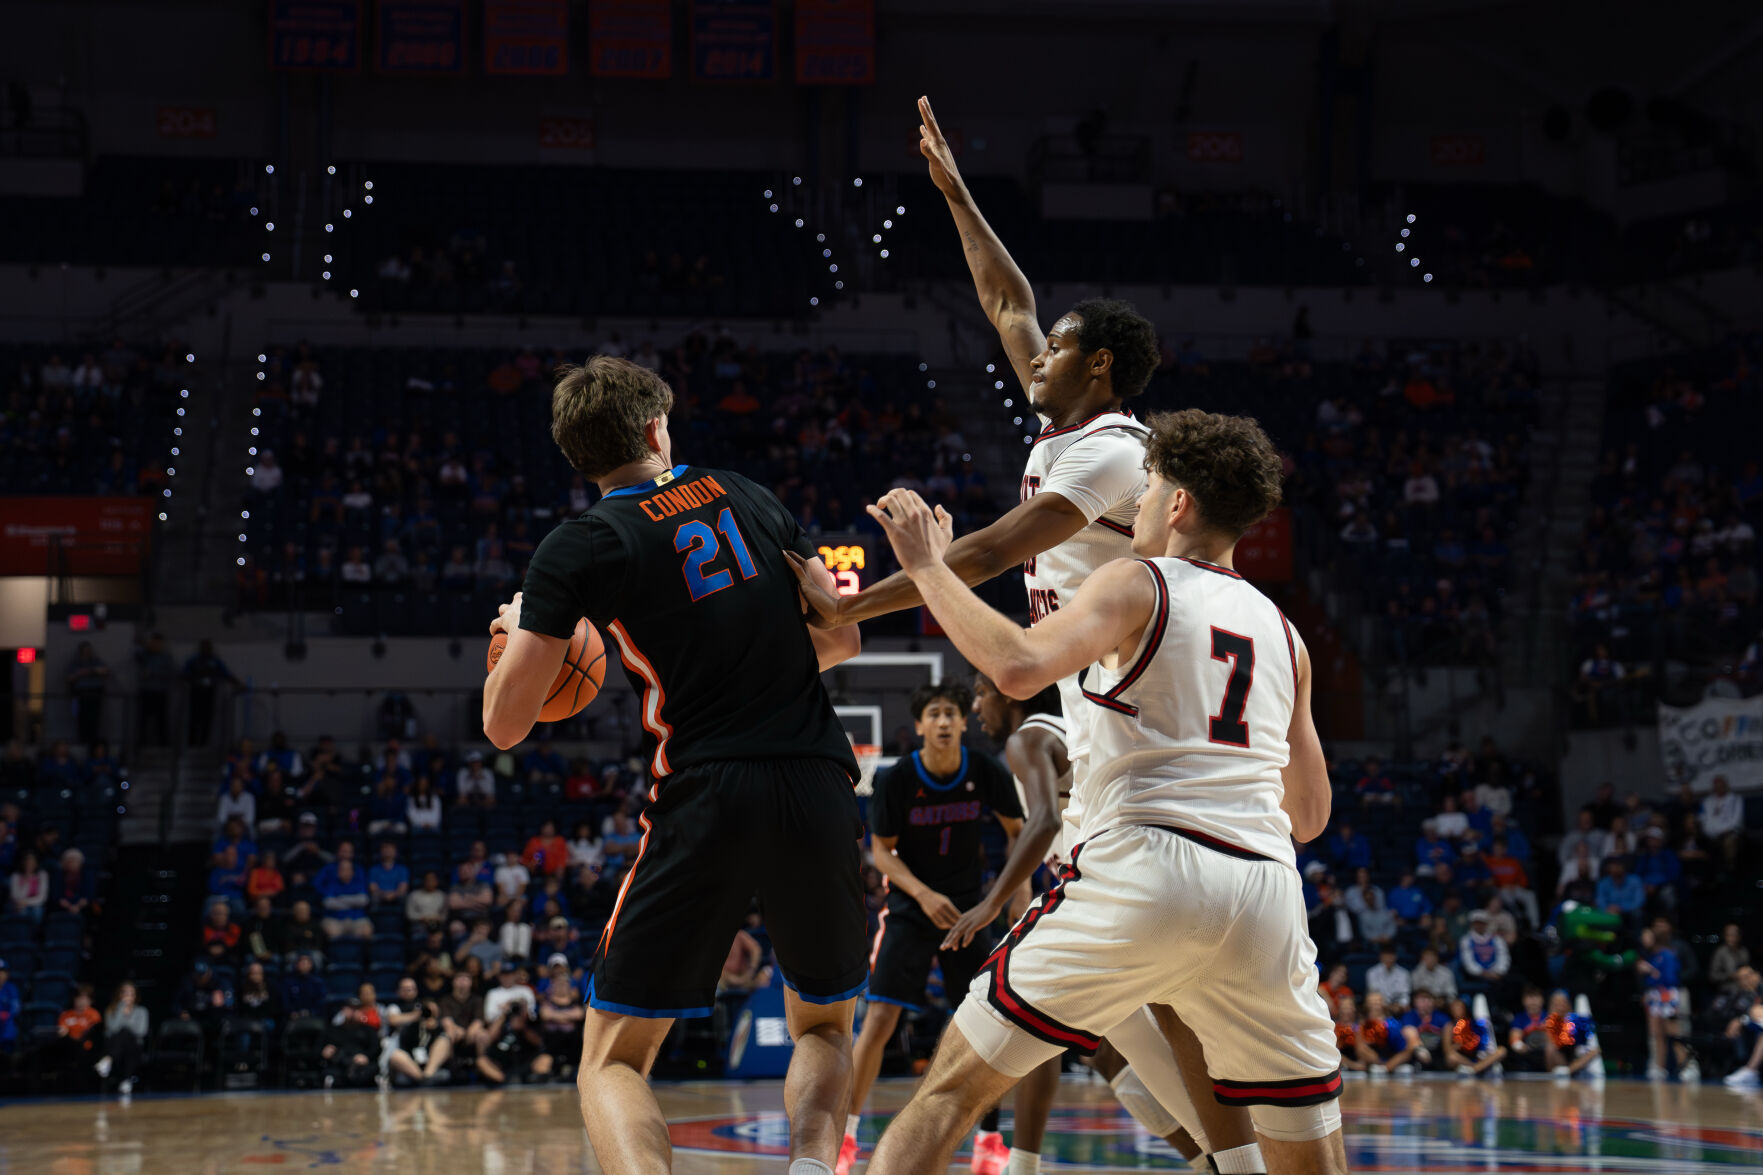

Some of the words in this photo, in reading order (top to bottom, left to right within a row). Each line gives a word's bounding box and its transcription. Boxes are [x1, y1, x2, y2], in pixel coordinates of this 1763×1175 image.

[159, 109, 216, 133] 204
[638, 475, 728, 523] CONDON
[673, 506, 759, 603] 21
[1208, 624, 1256, 749] 7
[908, 800, 981, 826] GATORS
[938, 826, 952, 856] 1
